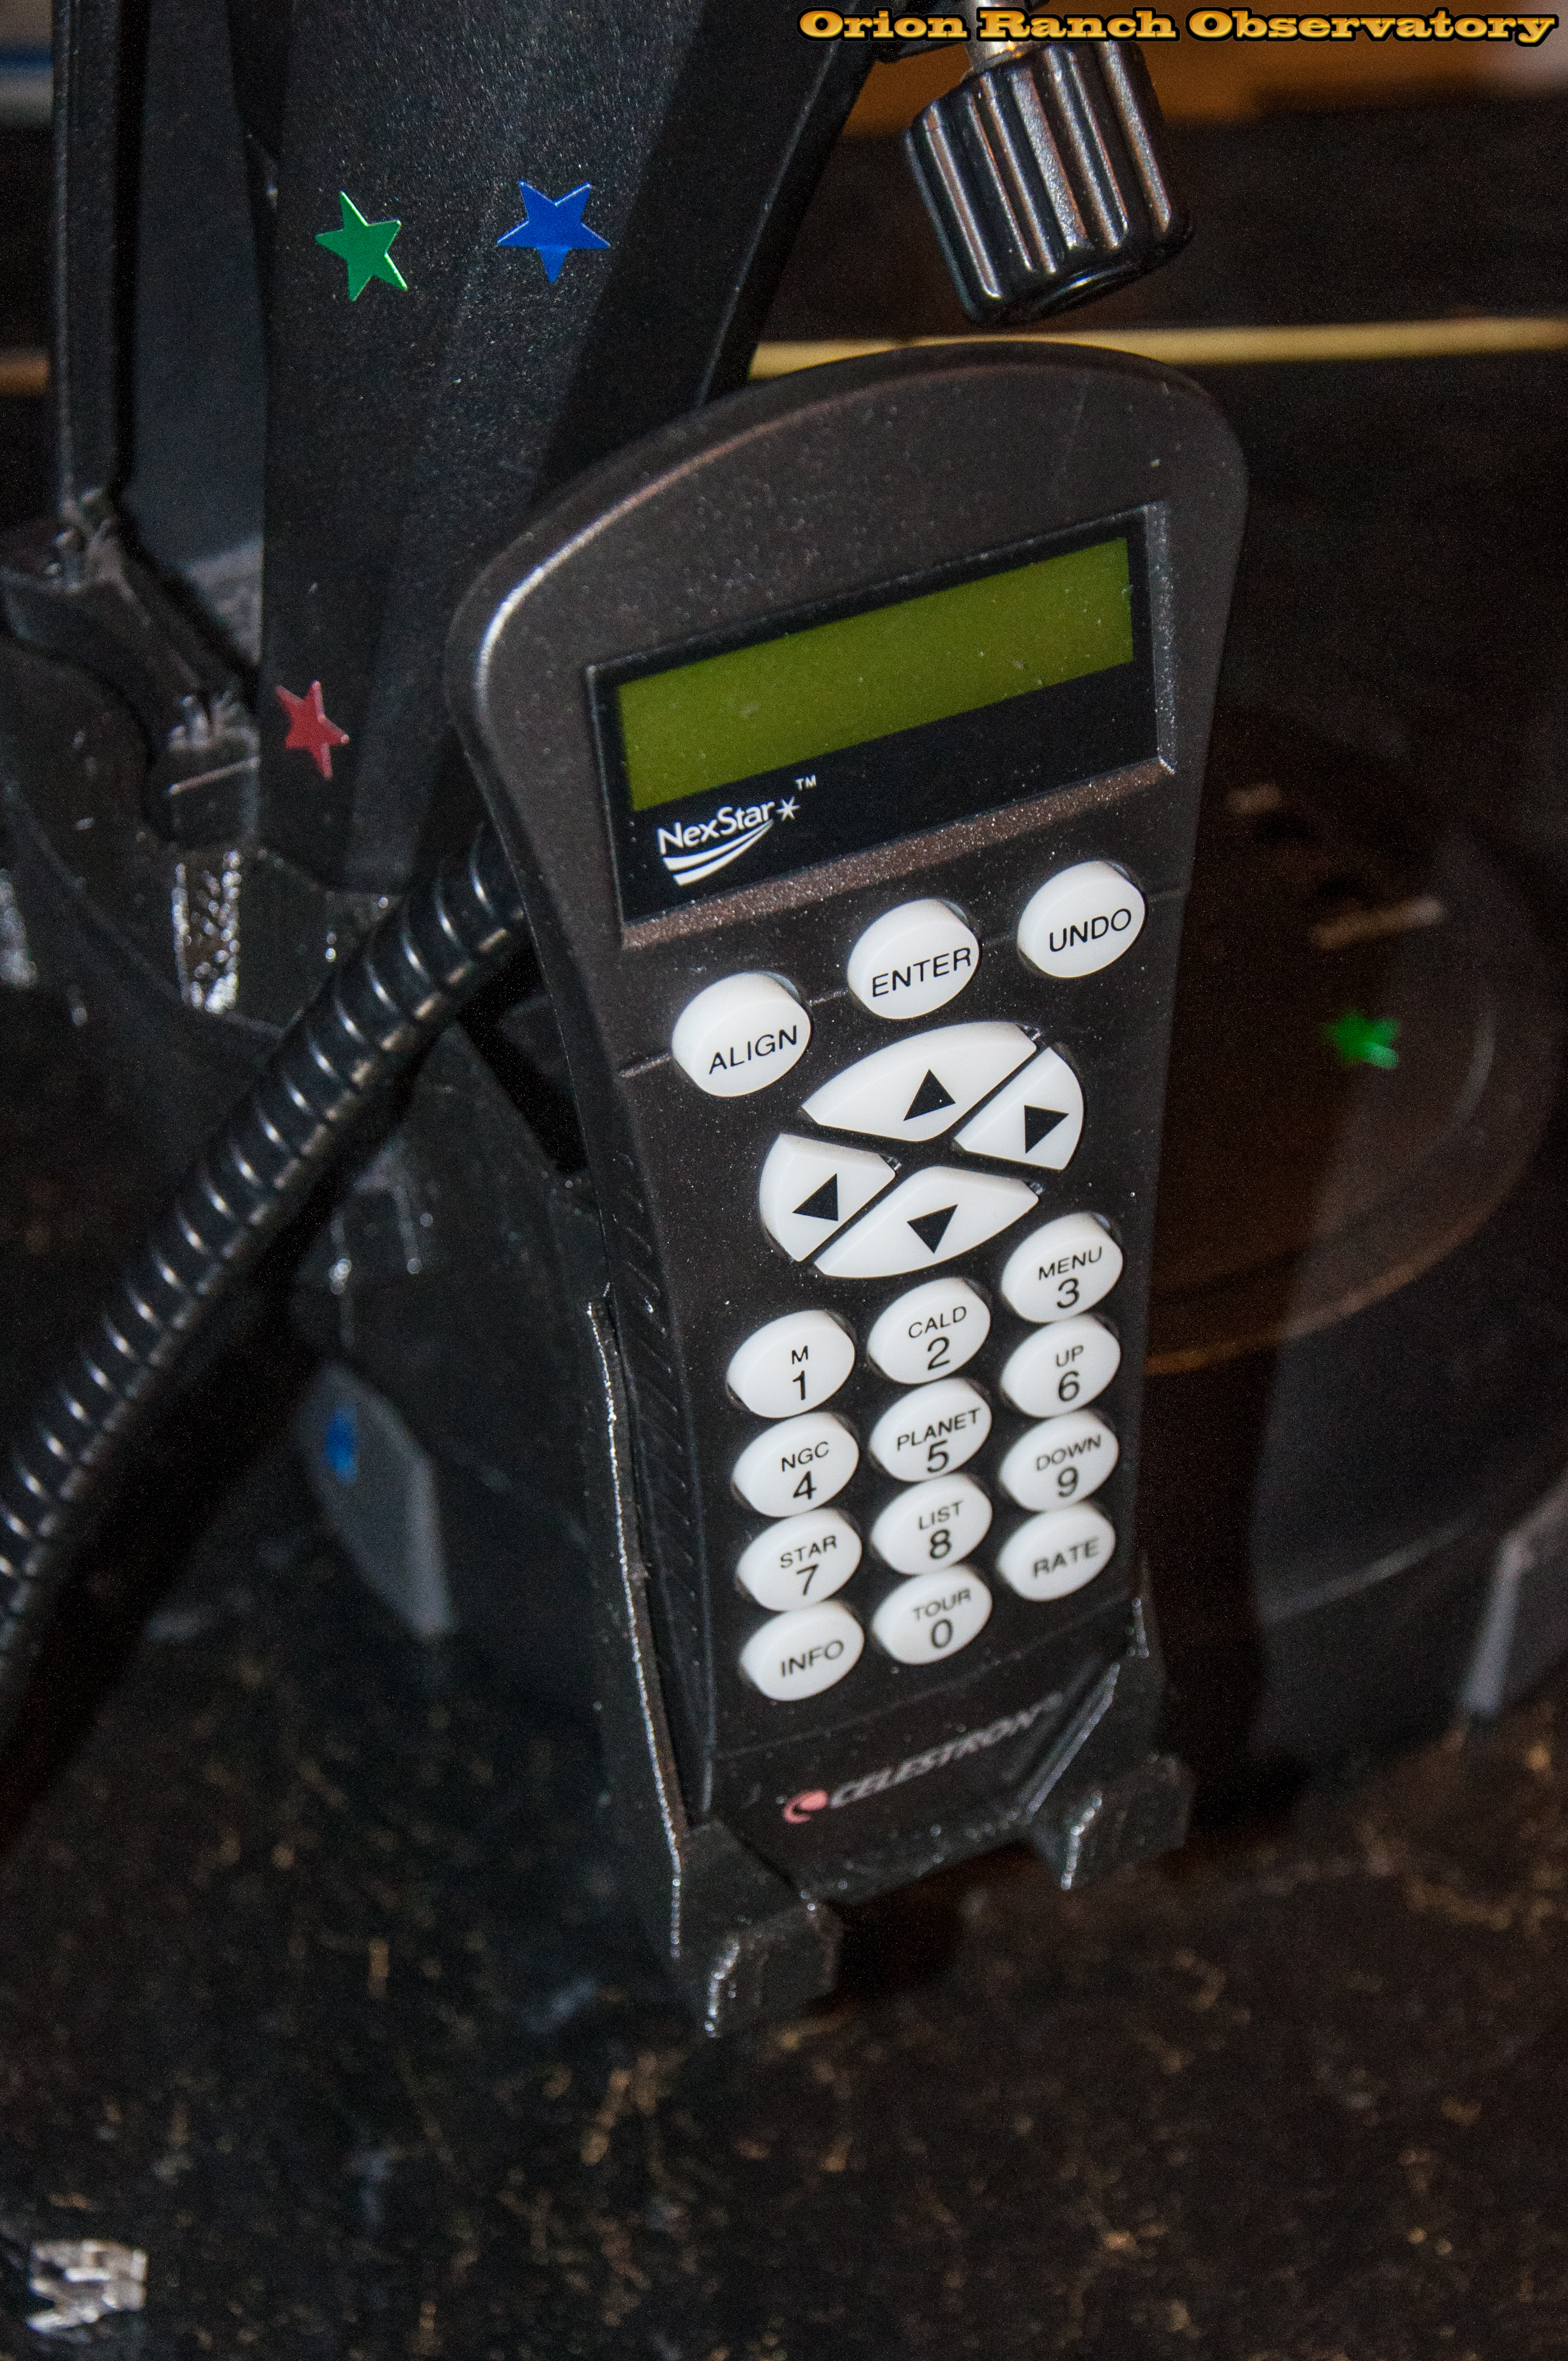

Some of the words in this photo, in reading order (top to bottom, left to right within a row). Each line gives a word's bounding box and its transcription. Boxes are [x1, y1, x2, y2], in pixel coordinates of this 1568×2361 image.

[657, 801, 774, 855] NexStar
[1049, 908, 1132, 953] UNDO
[872, 947, 971, 998] ENTER
[709, 1024, 797, 1075] ALIGN
[1038, 1246, 1102, 1280] MENU
[1056, 1277, 1080, 1309] 3
[908, 1306, 967, 1339] CALD
[791, 1345, 809, 1364] M
[927, 1336, 950, 1371] 2
[1056, 1345, 1084, 1367] UP
[792, 1370, 806, 1401] 1
[1057, 1371, 1080, 1403] 6
[897, 1408, 980, 1450] PLANET
[781, 1441, 829, 1472] NGC
[926, 1440, 949, 1473] 5
[1036, 1434, 1102, 1470] DOWN
[792, 1470, 817, 1500] 4
[1057, 1466, 1079, 1498] 9
[919, 1500, 962, 1530] LIST
[780, 1535, 837, 1568] STAR
[929, 1528, 952, 1560] 8
[1033, 1537, 1099, 1577] RATE
[796, 1564, 819, 1596] 7
[912, 1588, 971, 1621] TOUR
[930, 1619, 953, 1649] 0
[781, 1640, 844, 1677] INFO
